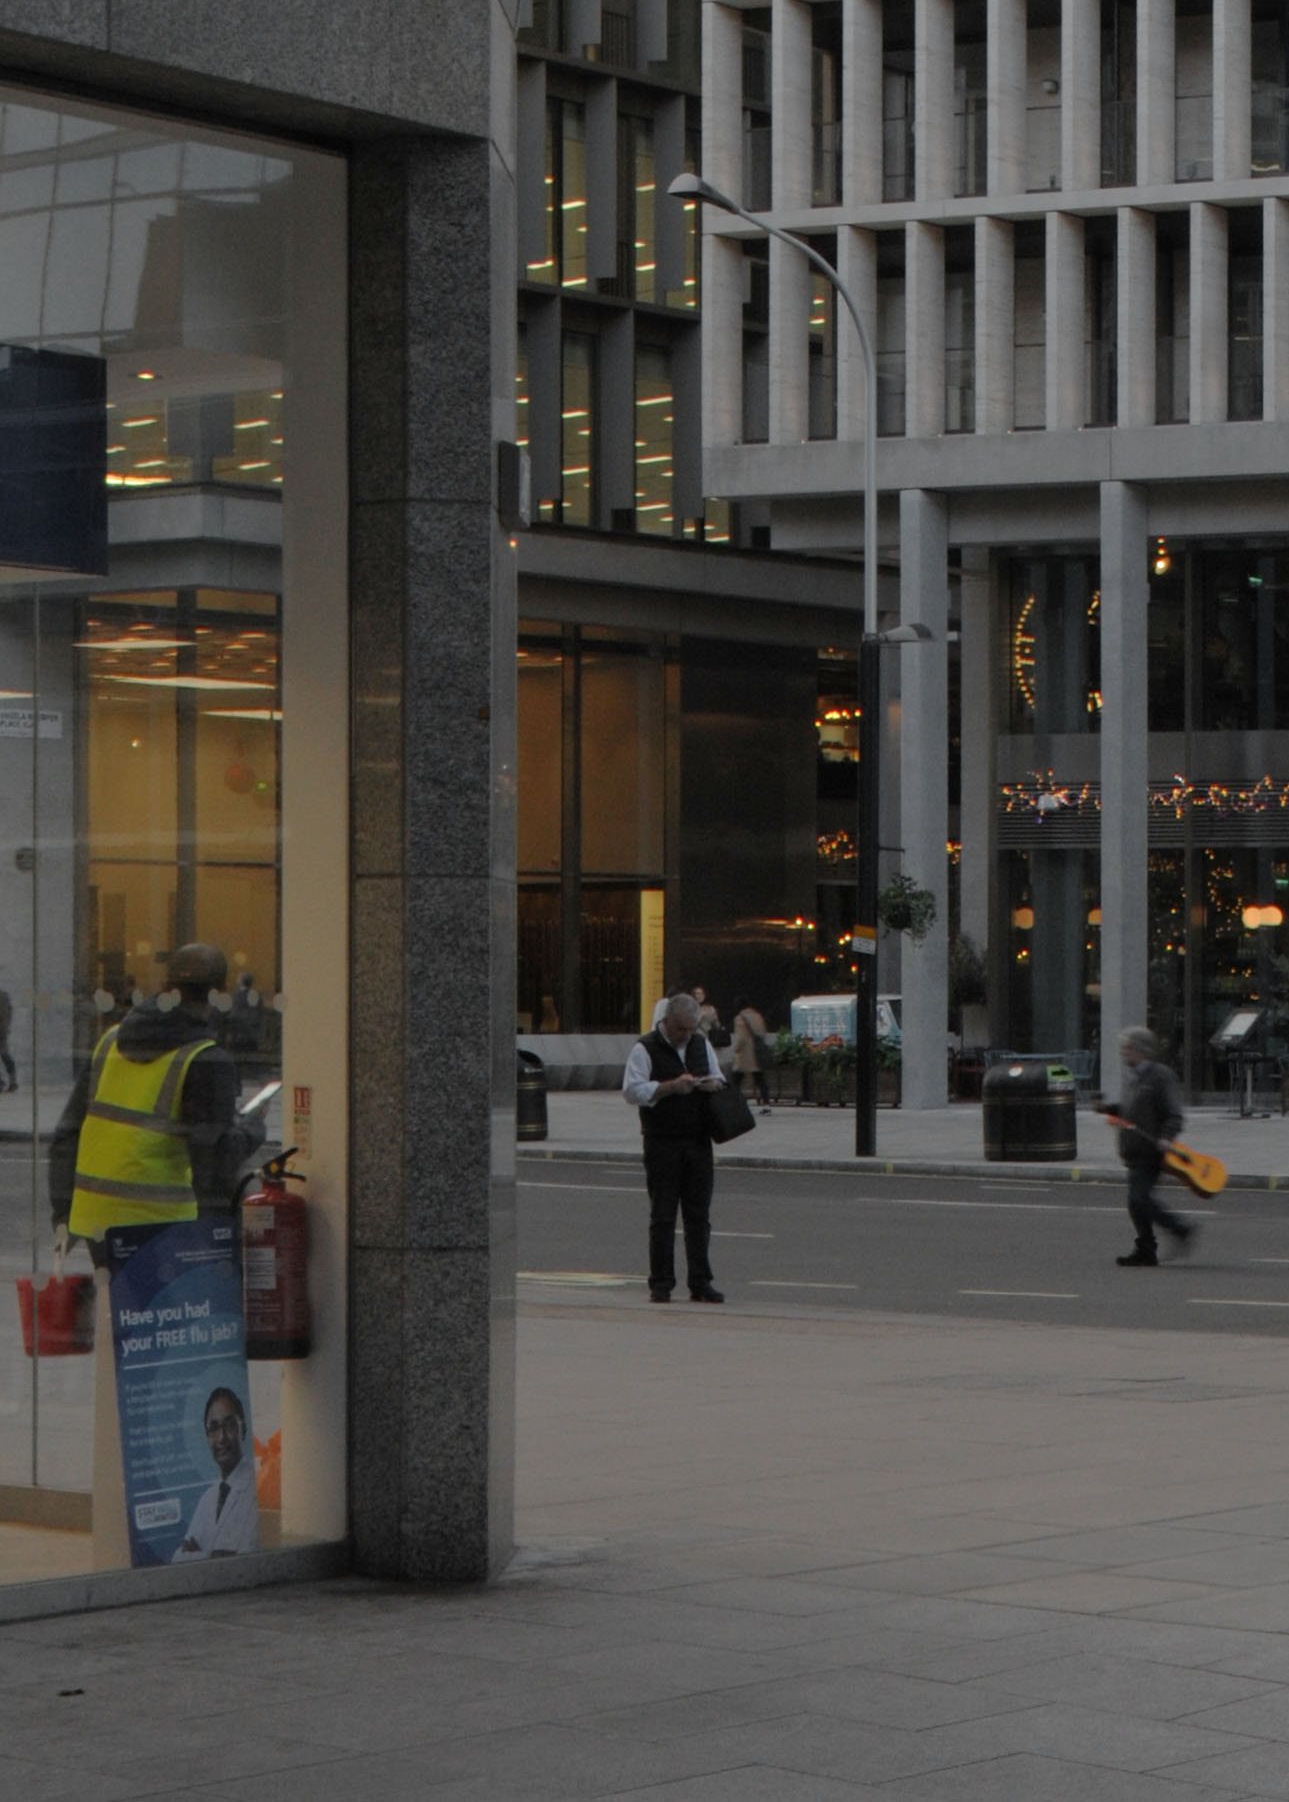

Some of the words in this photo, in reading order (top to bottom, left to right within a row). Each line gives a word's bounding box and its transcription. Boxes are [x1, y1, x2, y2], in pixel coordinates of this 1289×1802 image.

[119, 1309, 154, 1327] Have
[156, 1307, 182, 1327] you
[184, 1299, 210, 1319] had
[121, 1336, 153, 1357] your
[156, 1328, 187, 1349] FREE
[190, 1326, 209, 1344] flu
[211, 1322, 239, 1346] jab?
